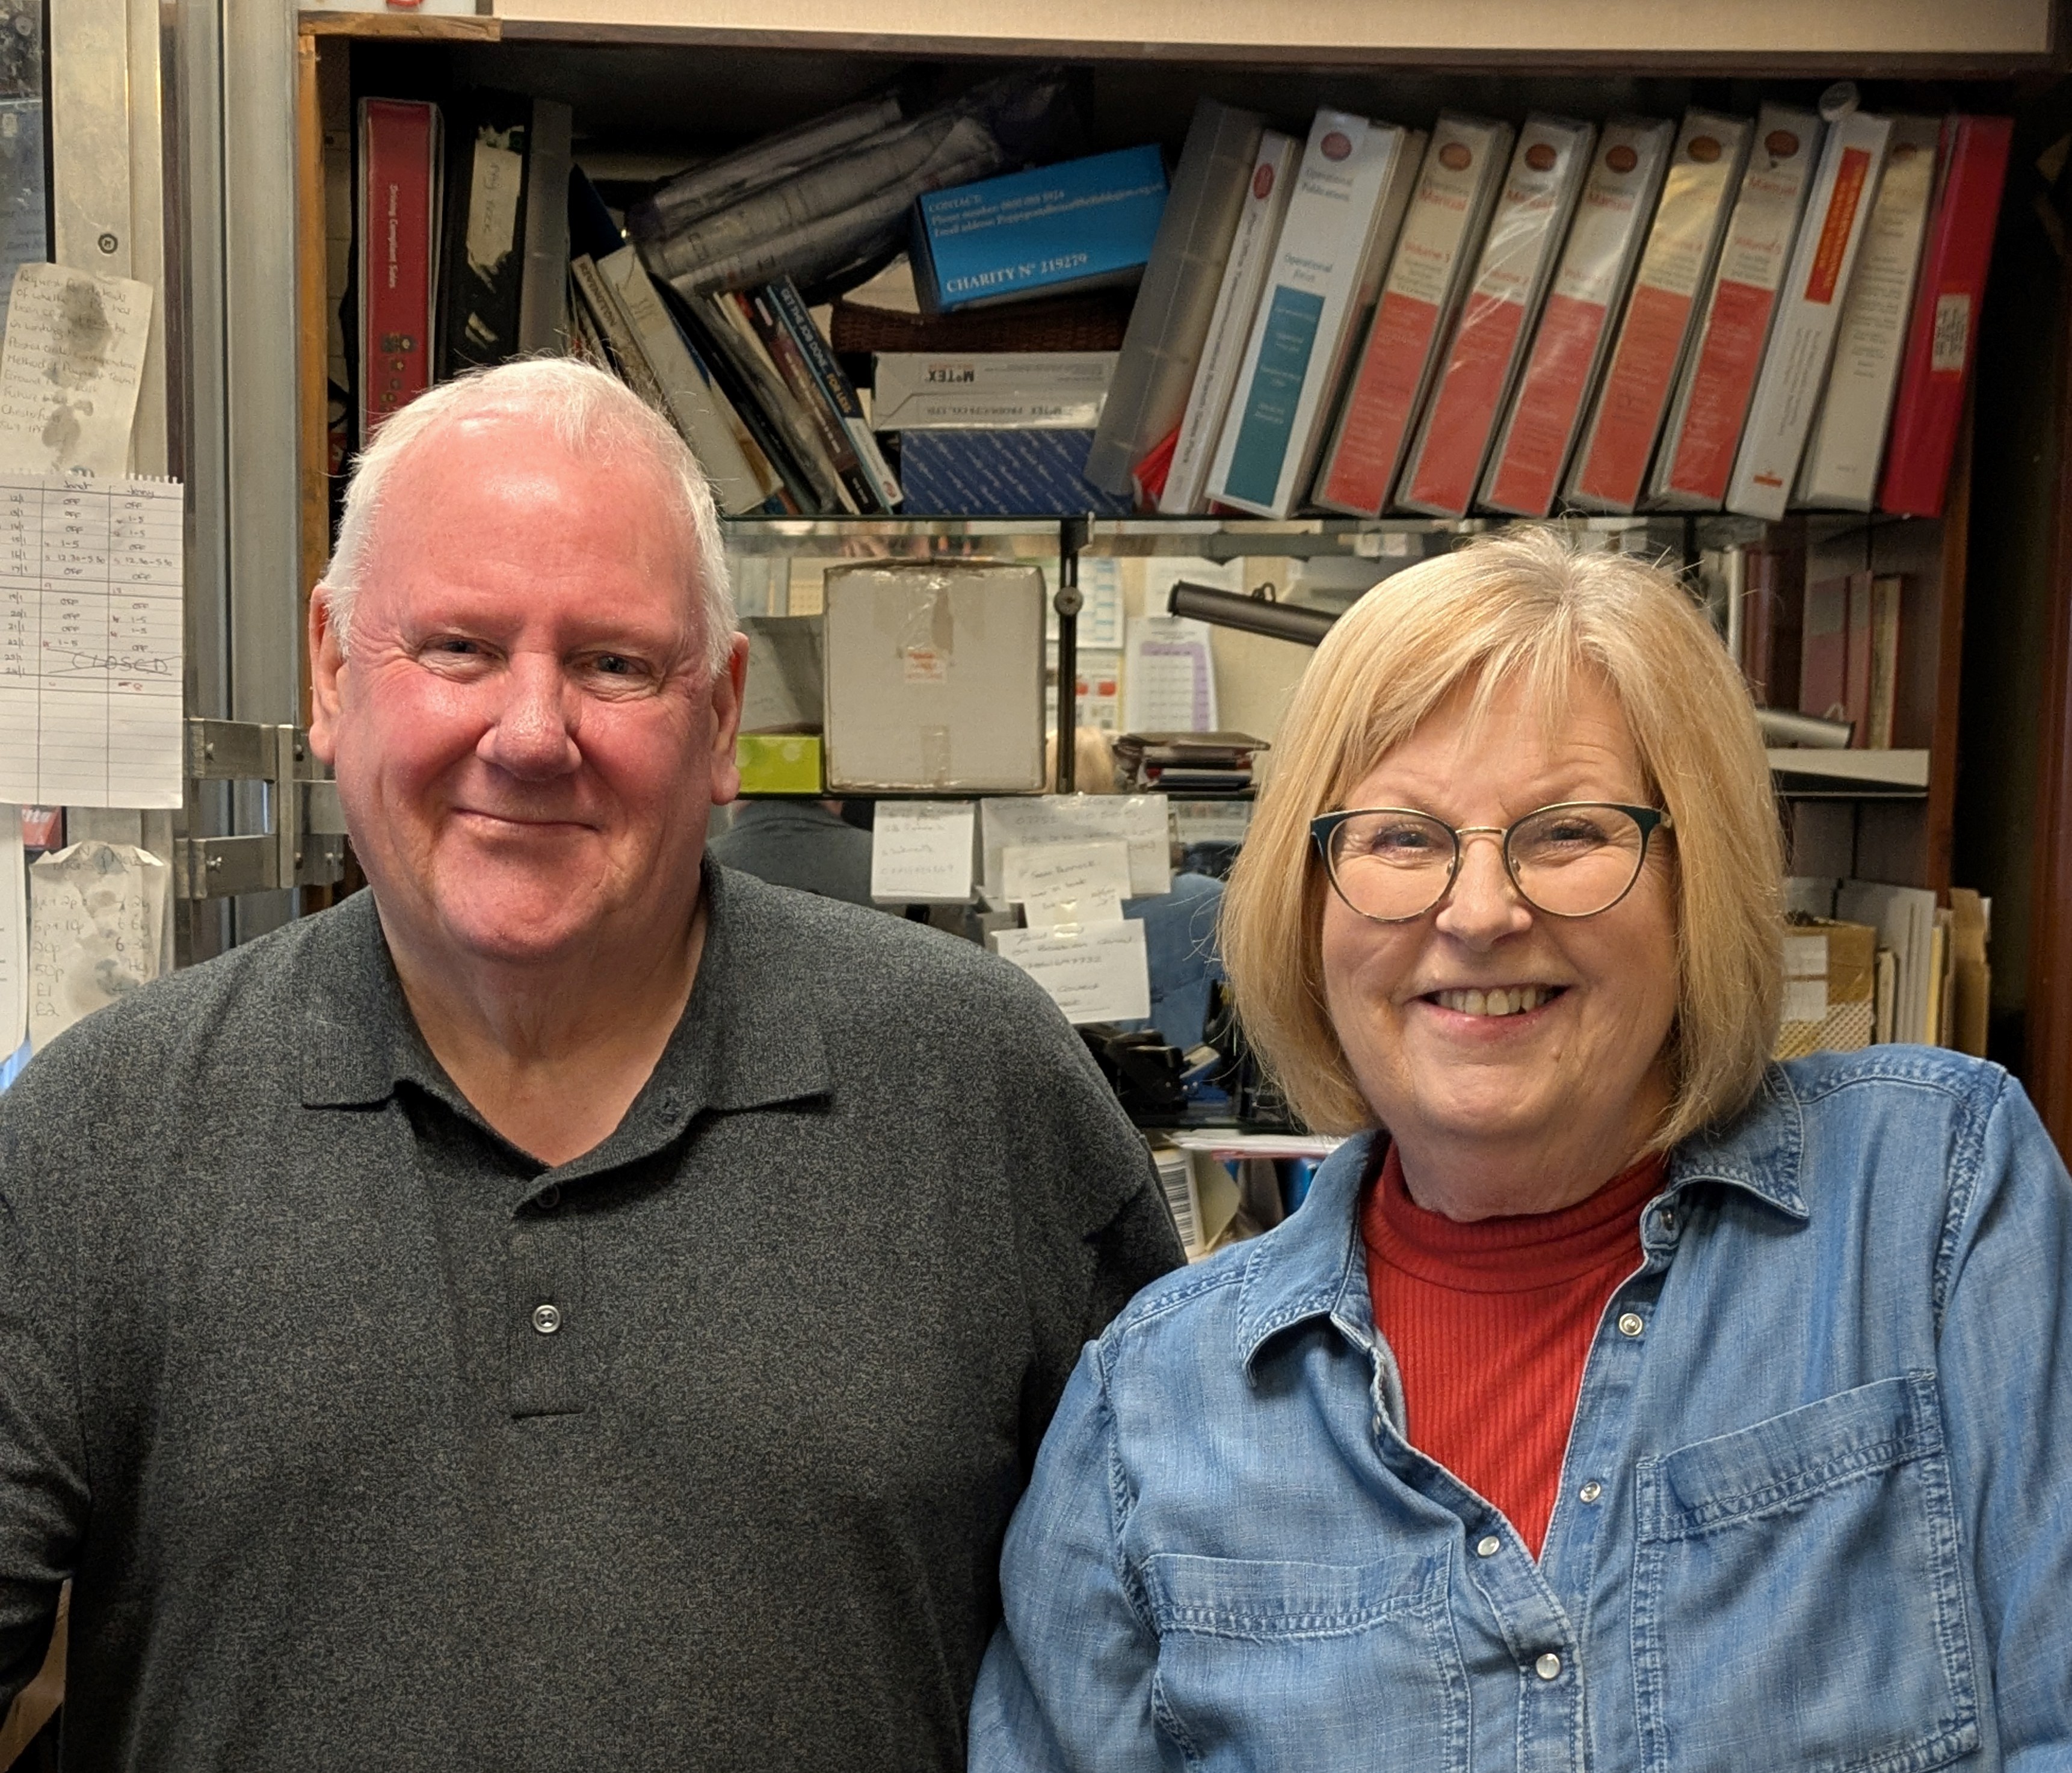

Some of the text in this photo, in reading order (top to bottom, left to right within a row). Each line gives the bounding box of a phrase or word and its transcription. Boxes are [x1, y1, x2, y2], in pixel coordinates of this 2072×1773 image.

[946, 267, 1016, 293] CHARITY
[1040, 252, 1089, 274] 219279
[779, 287, 796, 307] GET
[789, 305, 806, 325] THE
[798, 322, 815, 344] JOB
[825, 372, 842, 393] FOR
[6, 354, 46, 369] Method
[10, 493, 143, 510] 12/1 OFF OFF
[64, 510, 82, 519] OFF
[64, 525, 84, 535] OFF
[129, 529, 146, 537] 1-5
[61, 539, 79, 548] 1-5
[64, 567, 83, 576] OFF
[132, 572, 152, 581] OFF
[60, 597, 79, 606] OFF
[10, 608, 27, 620] 20/1
[8, 621, 25, 634] 21/1
[72, 655, 168, 673] CLOSED
[34, 963, 64, 983] 50p
